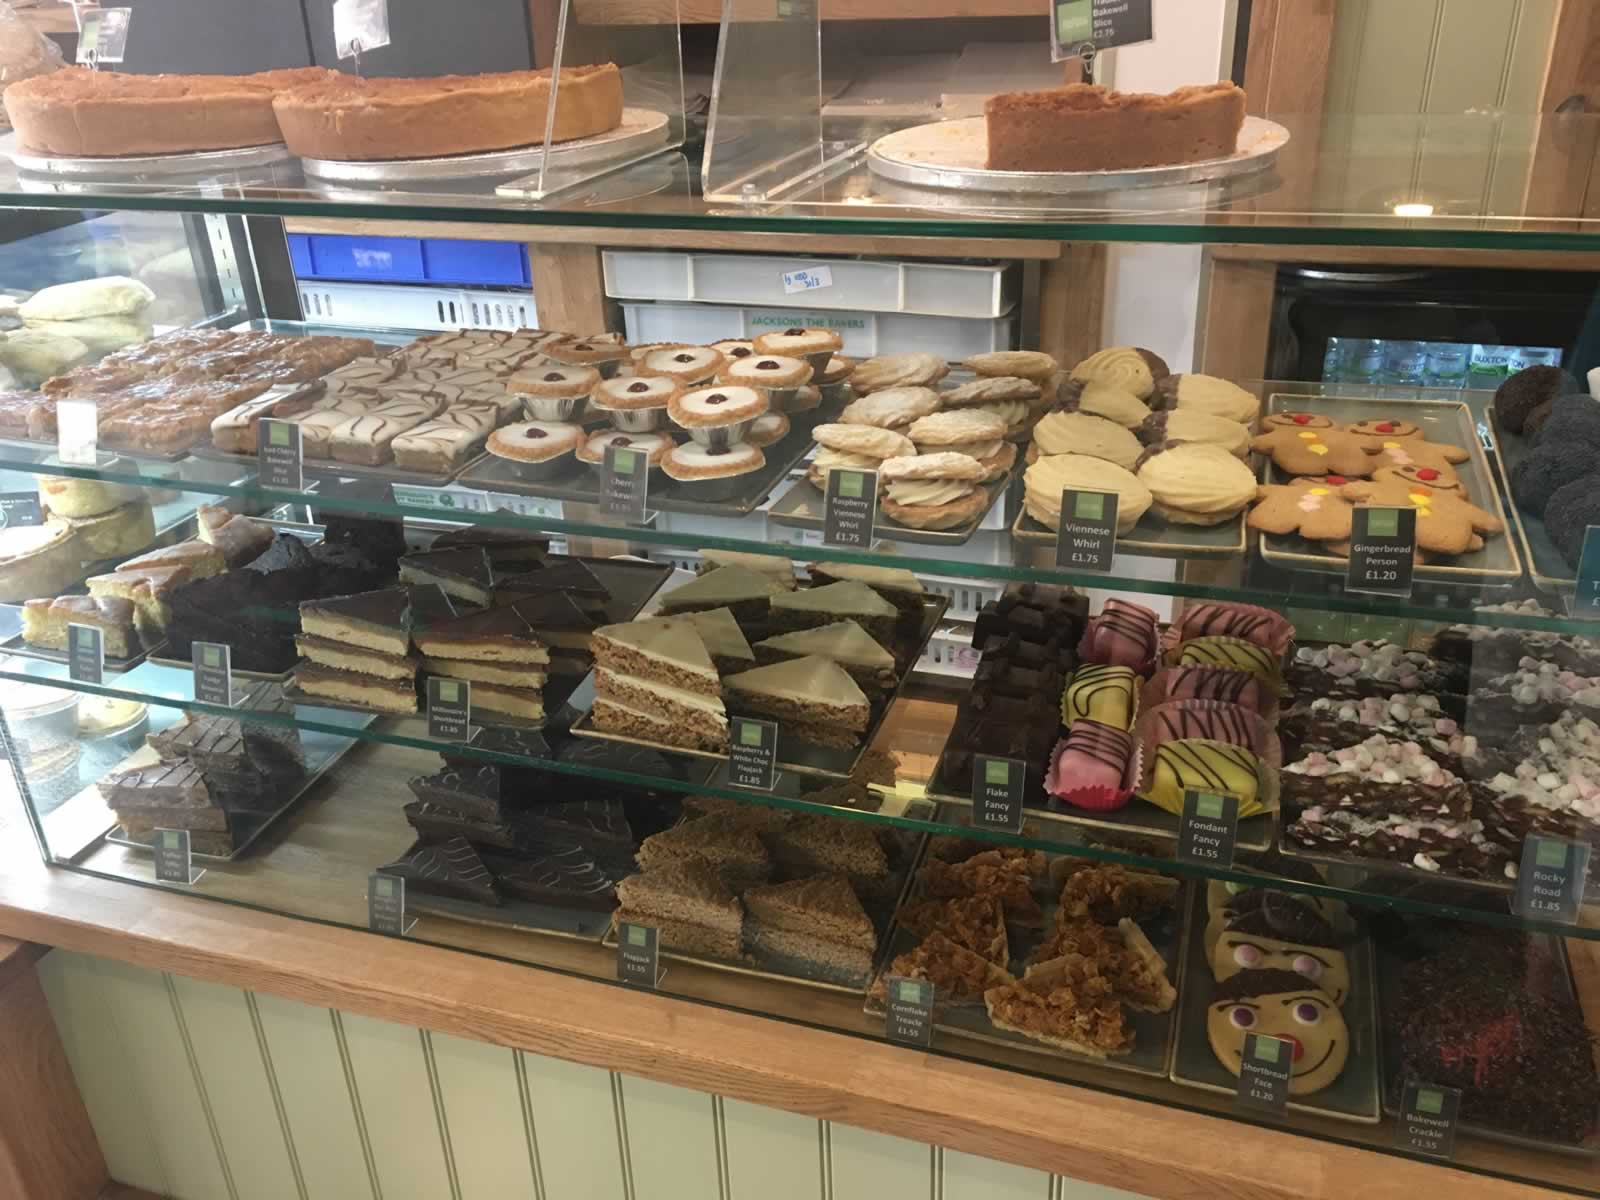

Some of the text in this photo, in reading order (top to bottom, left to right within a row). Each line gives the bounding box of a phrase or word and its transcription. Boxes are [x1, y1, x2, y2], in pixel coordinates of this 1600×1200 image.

[1093, 4, 1128, 16] Bakewell
[1094, 19, 1112, 28] Slice
[752, 317, 864, 328] JACKSONS THE BAKERS
[1474, 354, 1507, 364] BUXTON
[833, 497, 868, 508] Raspberry
[834, 508, 866, 518] Viennese
[840, 521, 858, 529] Whirl
[1065, 523, 1110, 535] Viennese
[836, 532, 859, 542] £1.75
[1073, 539, 1100, 549] Whirl
[1354, 544, 1411, 554] Gingerbread
[1072, 553, 1098, 563] £1.75
[1366, 557, 1397, 565] Person
[1366, 571, 1397, 580] £1.20
[732, 744, 763, 755] Raspberry
[753, 757, 768, 765] Choc
[738, 764, 762, 774] Flapjack
[739, 775, 760, 784] £1.85
[986, 788, 1008, 797] Flake
[985, 800, 1009, 811] Fancy
[985, 812, 1009, 822] £1.55
[1189, 820, 1228, 834] Fondant
[1193, 834, 1220, 846] Fancy
[1192, 847, 1217, 858] £1.55
[1533, 871, 1566, 884] Rocky
[1533, 885, 1560, 897] Road
[1530, 899, 1560, 911] £1.85
[892, 1003, 927, 1016] Cornflake
[896, 1015, 922, 1027] Treacle
[898, 1027, 919, 1037] £1.55
[1242, 1061, 1287, 1080] Shortbread
[1255, 1078, 1272, 1088] Face
[1250, 1089, 1273, 1100] £1.20
[1407, 1113, 1449, 1128] Bakewell
[1409, 1126, 1443, 1138] Crackle
